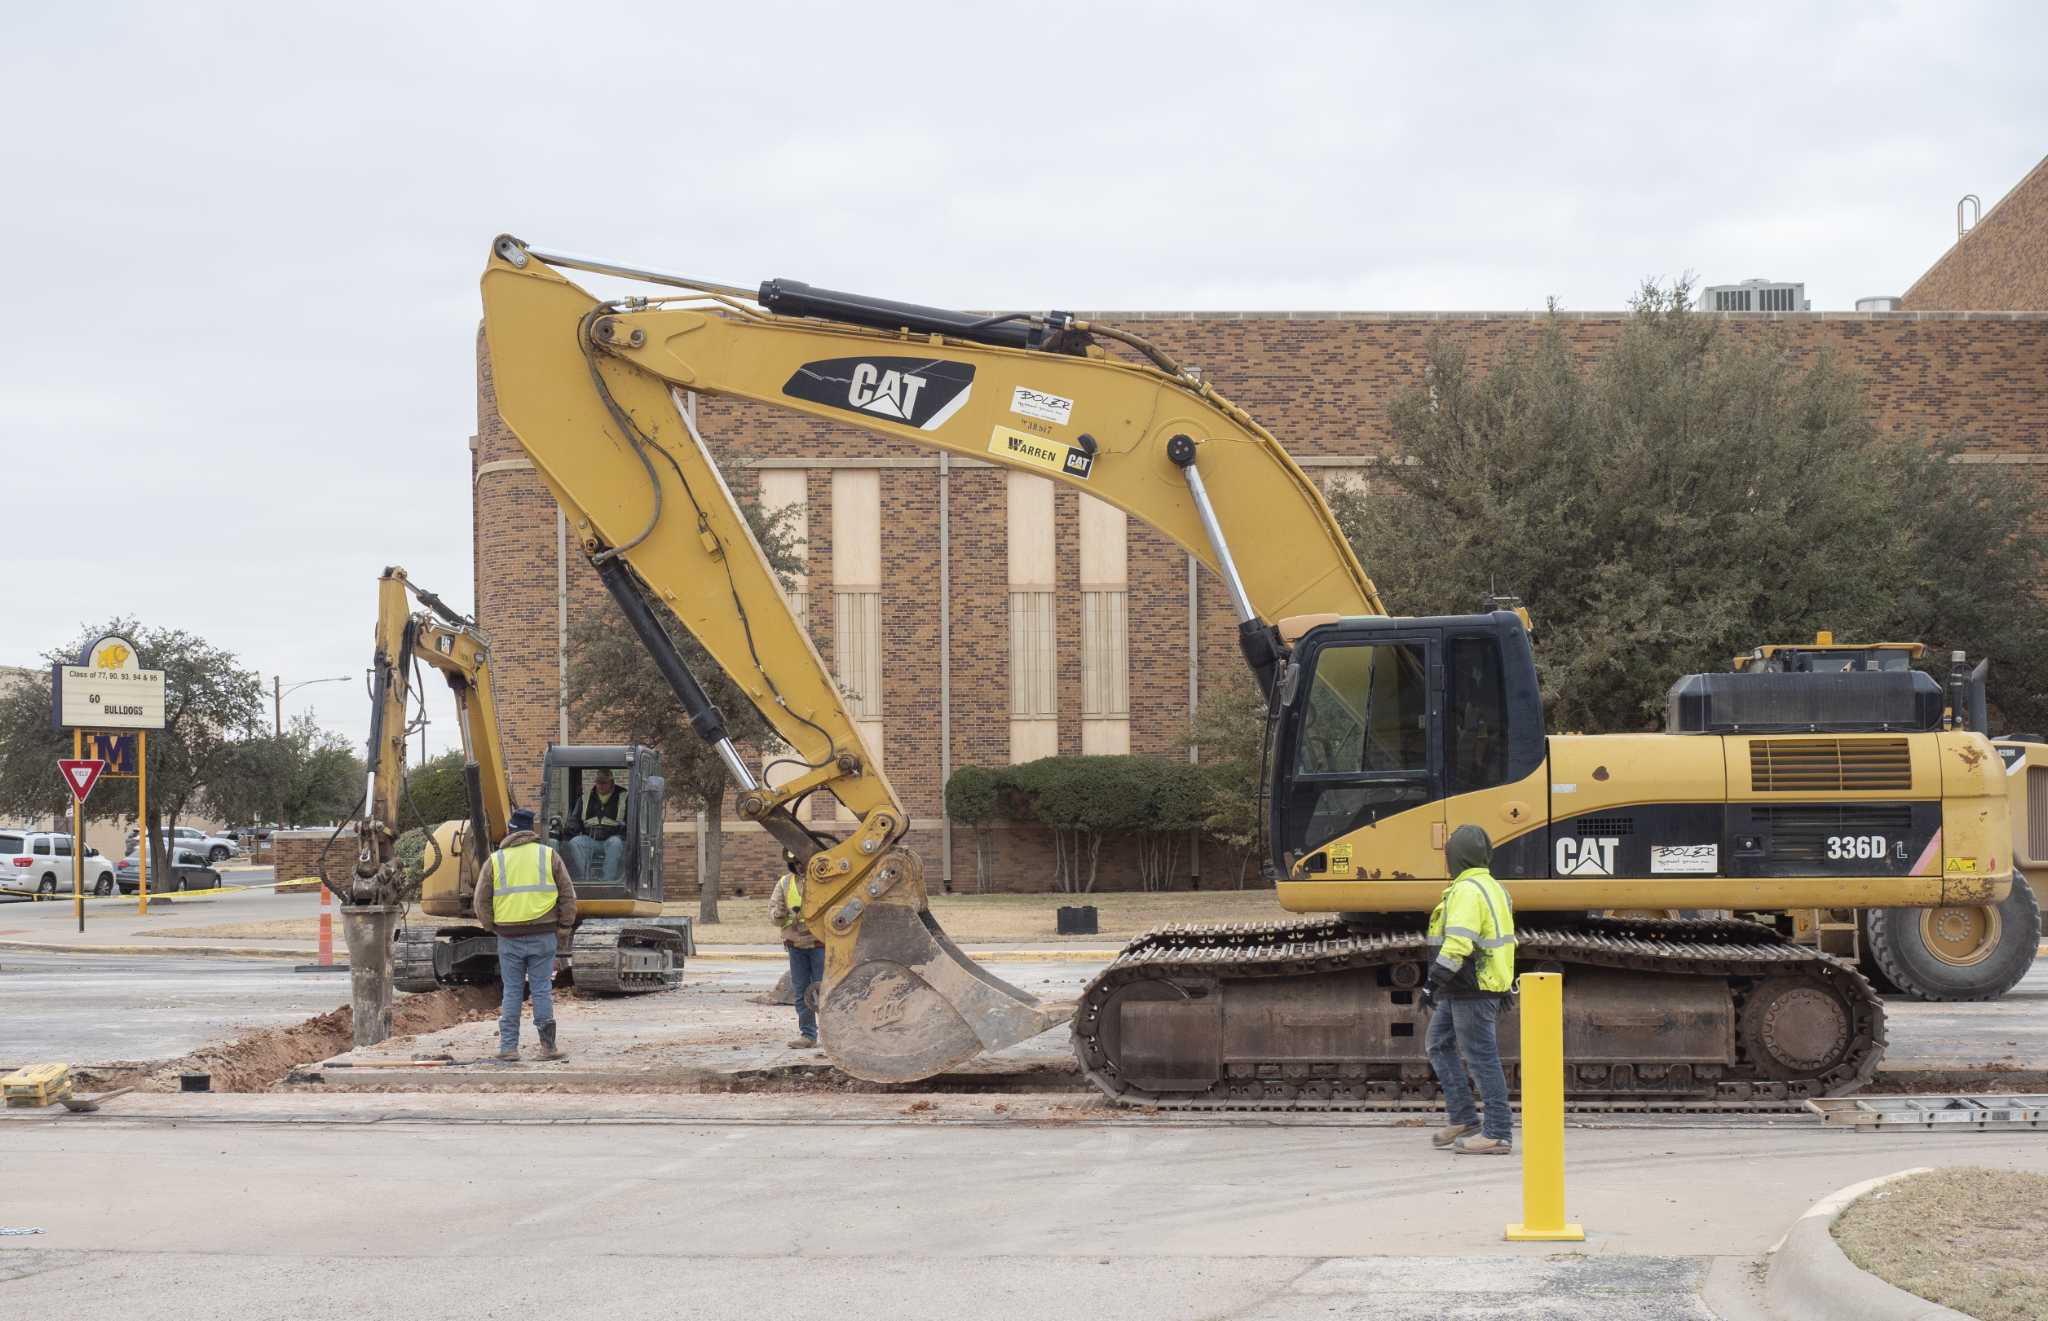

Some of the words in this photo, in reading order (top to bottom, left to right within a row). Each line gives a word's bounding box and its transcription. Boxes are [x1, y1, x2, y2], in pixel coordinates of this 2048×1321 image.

[848, 363, 927, 420] CAT
[1008, 437, 1057, 462] WARREN
[1067, 454, 1090, 471] CAT
[69, 670, 88, 678] Class
[89, 694, 100, 704] GO
[104, 705, 143, 715] BULLDOGS
[92, 735, 135, 772] M
[1556, 837, 1619, 875] CAT
[1827, 835, 1887, 860] 336D
[1896, 840, 1909, 859] L
